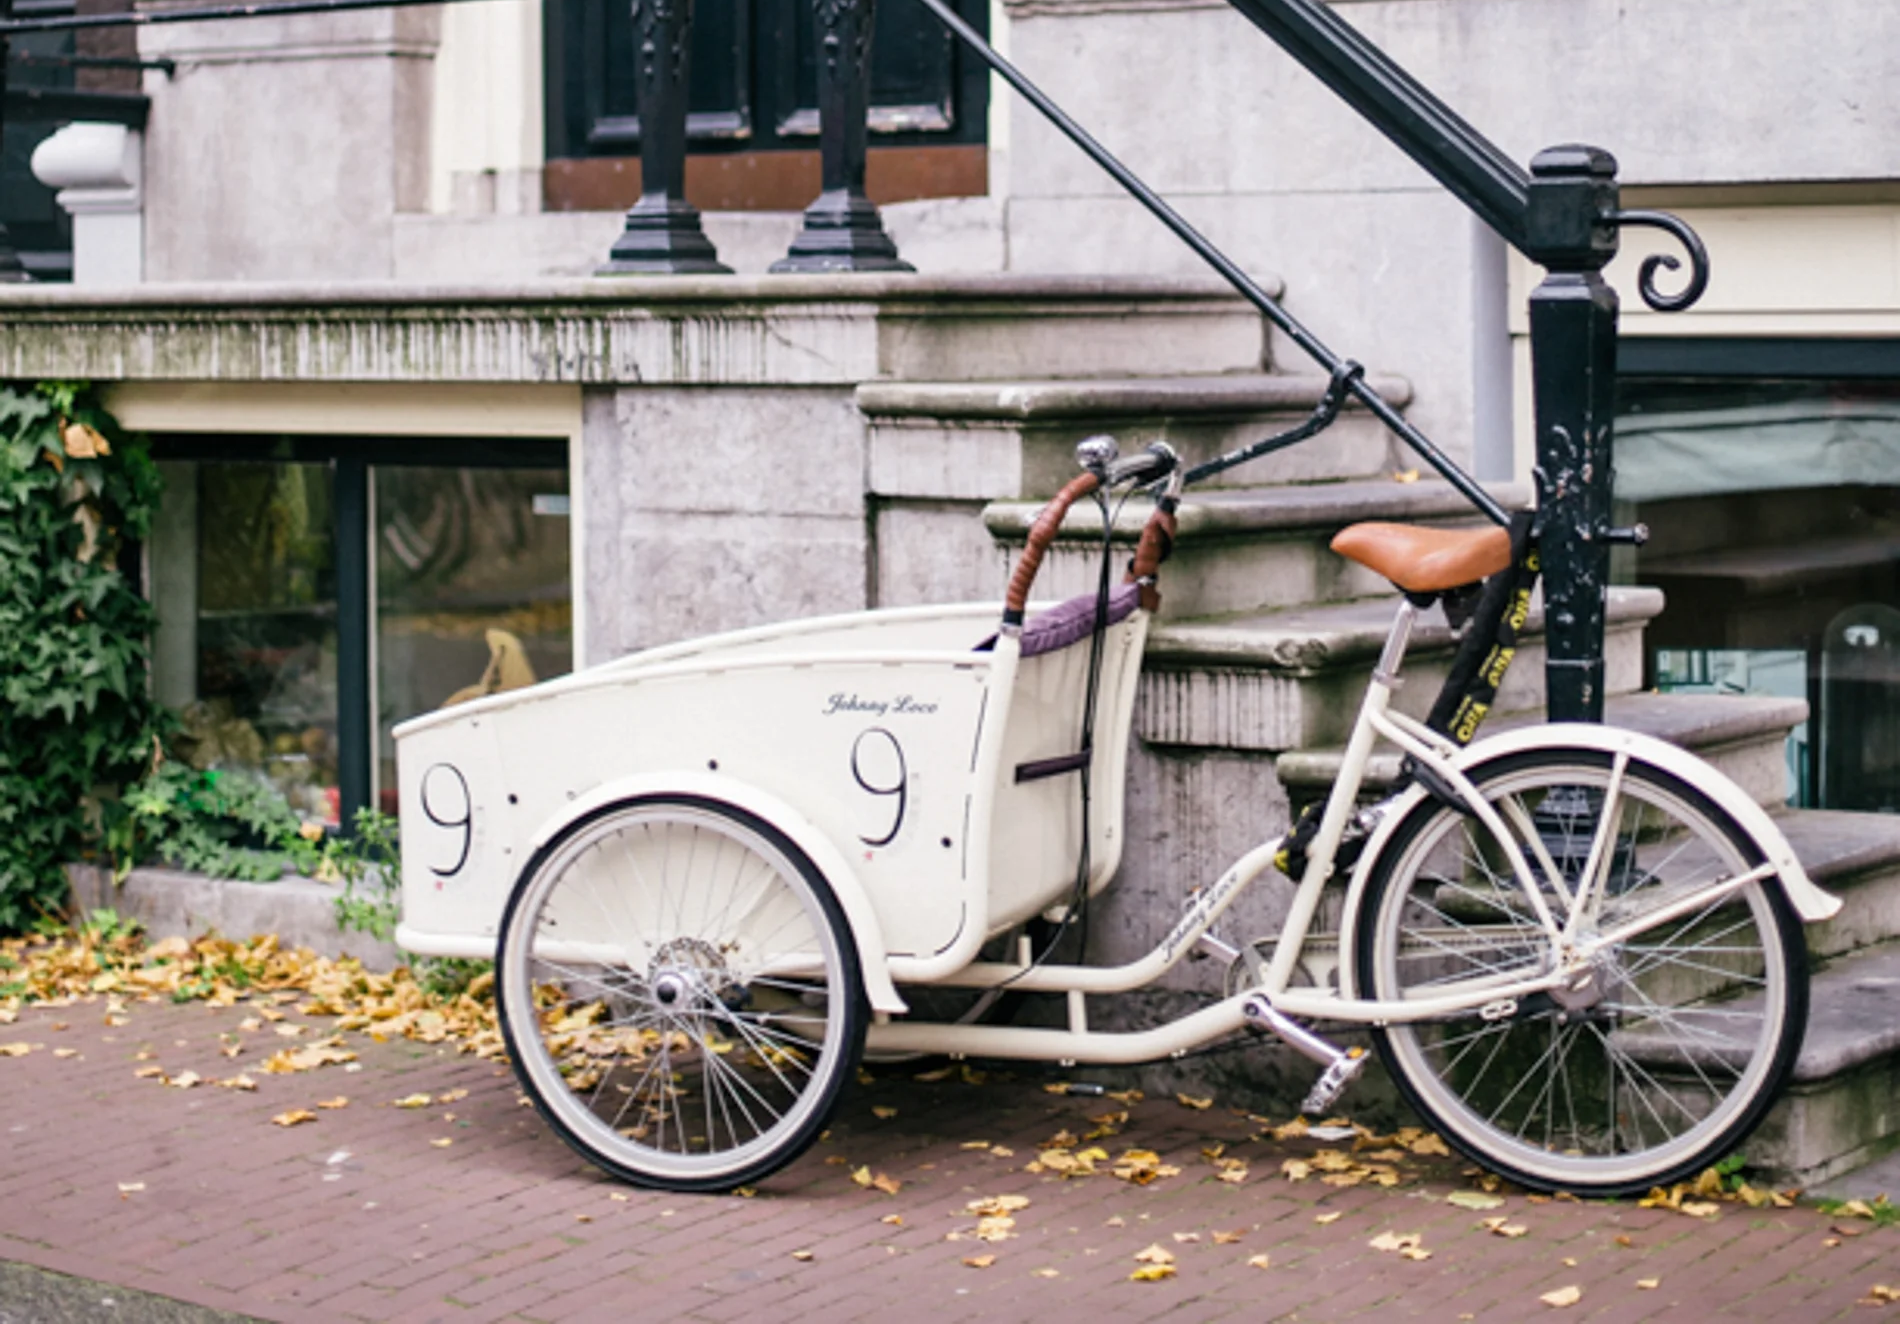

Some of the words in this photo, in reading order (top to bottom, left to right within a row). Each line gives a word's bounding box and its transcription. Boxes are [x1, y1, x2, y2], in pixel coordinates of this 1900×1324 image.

[822, 694, 888, 717] Johnny
[892, 695, 939, 714] Loco
[420, 762, 471, 878] 9
[851, 727, 907, 847] 9
